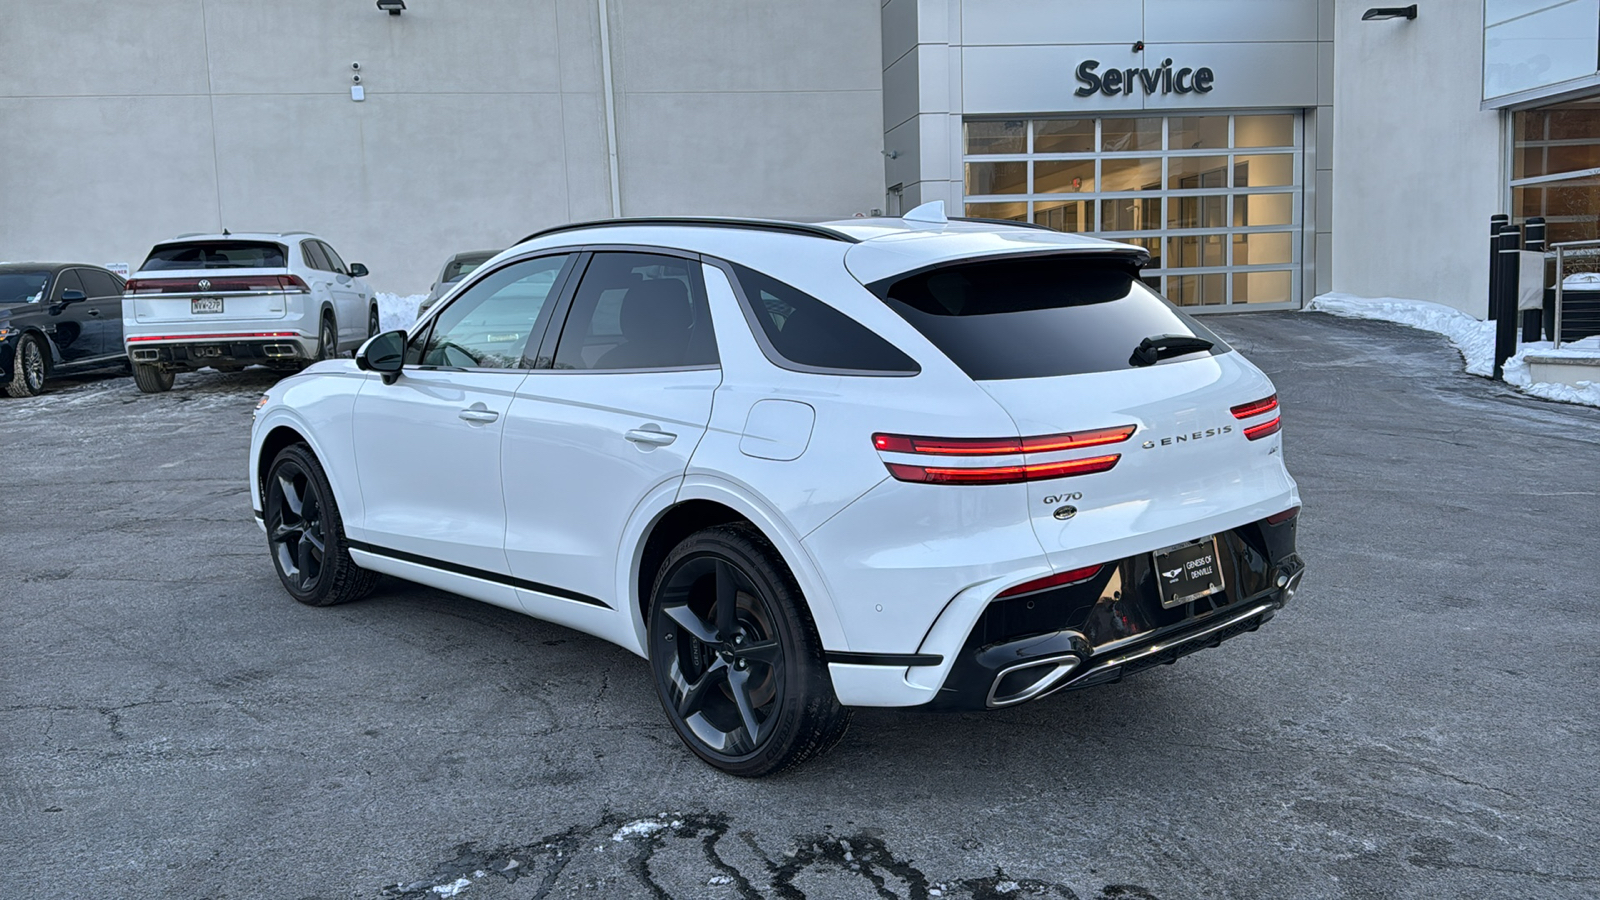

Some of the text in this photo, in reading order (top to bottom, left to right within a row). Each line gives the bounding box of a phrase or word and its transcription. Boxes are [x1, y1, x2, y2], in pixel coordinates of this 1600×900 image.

[1074, 58, 1214, 96] Service
[1142, 425, 1232, 449] GENESIS
[1043, 491, 1082, 504] GV70
[1186, 555, 1212, 570] GENESIS OF
[1191, 566, 1213, 579] DENVILLE
